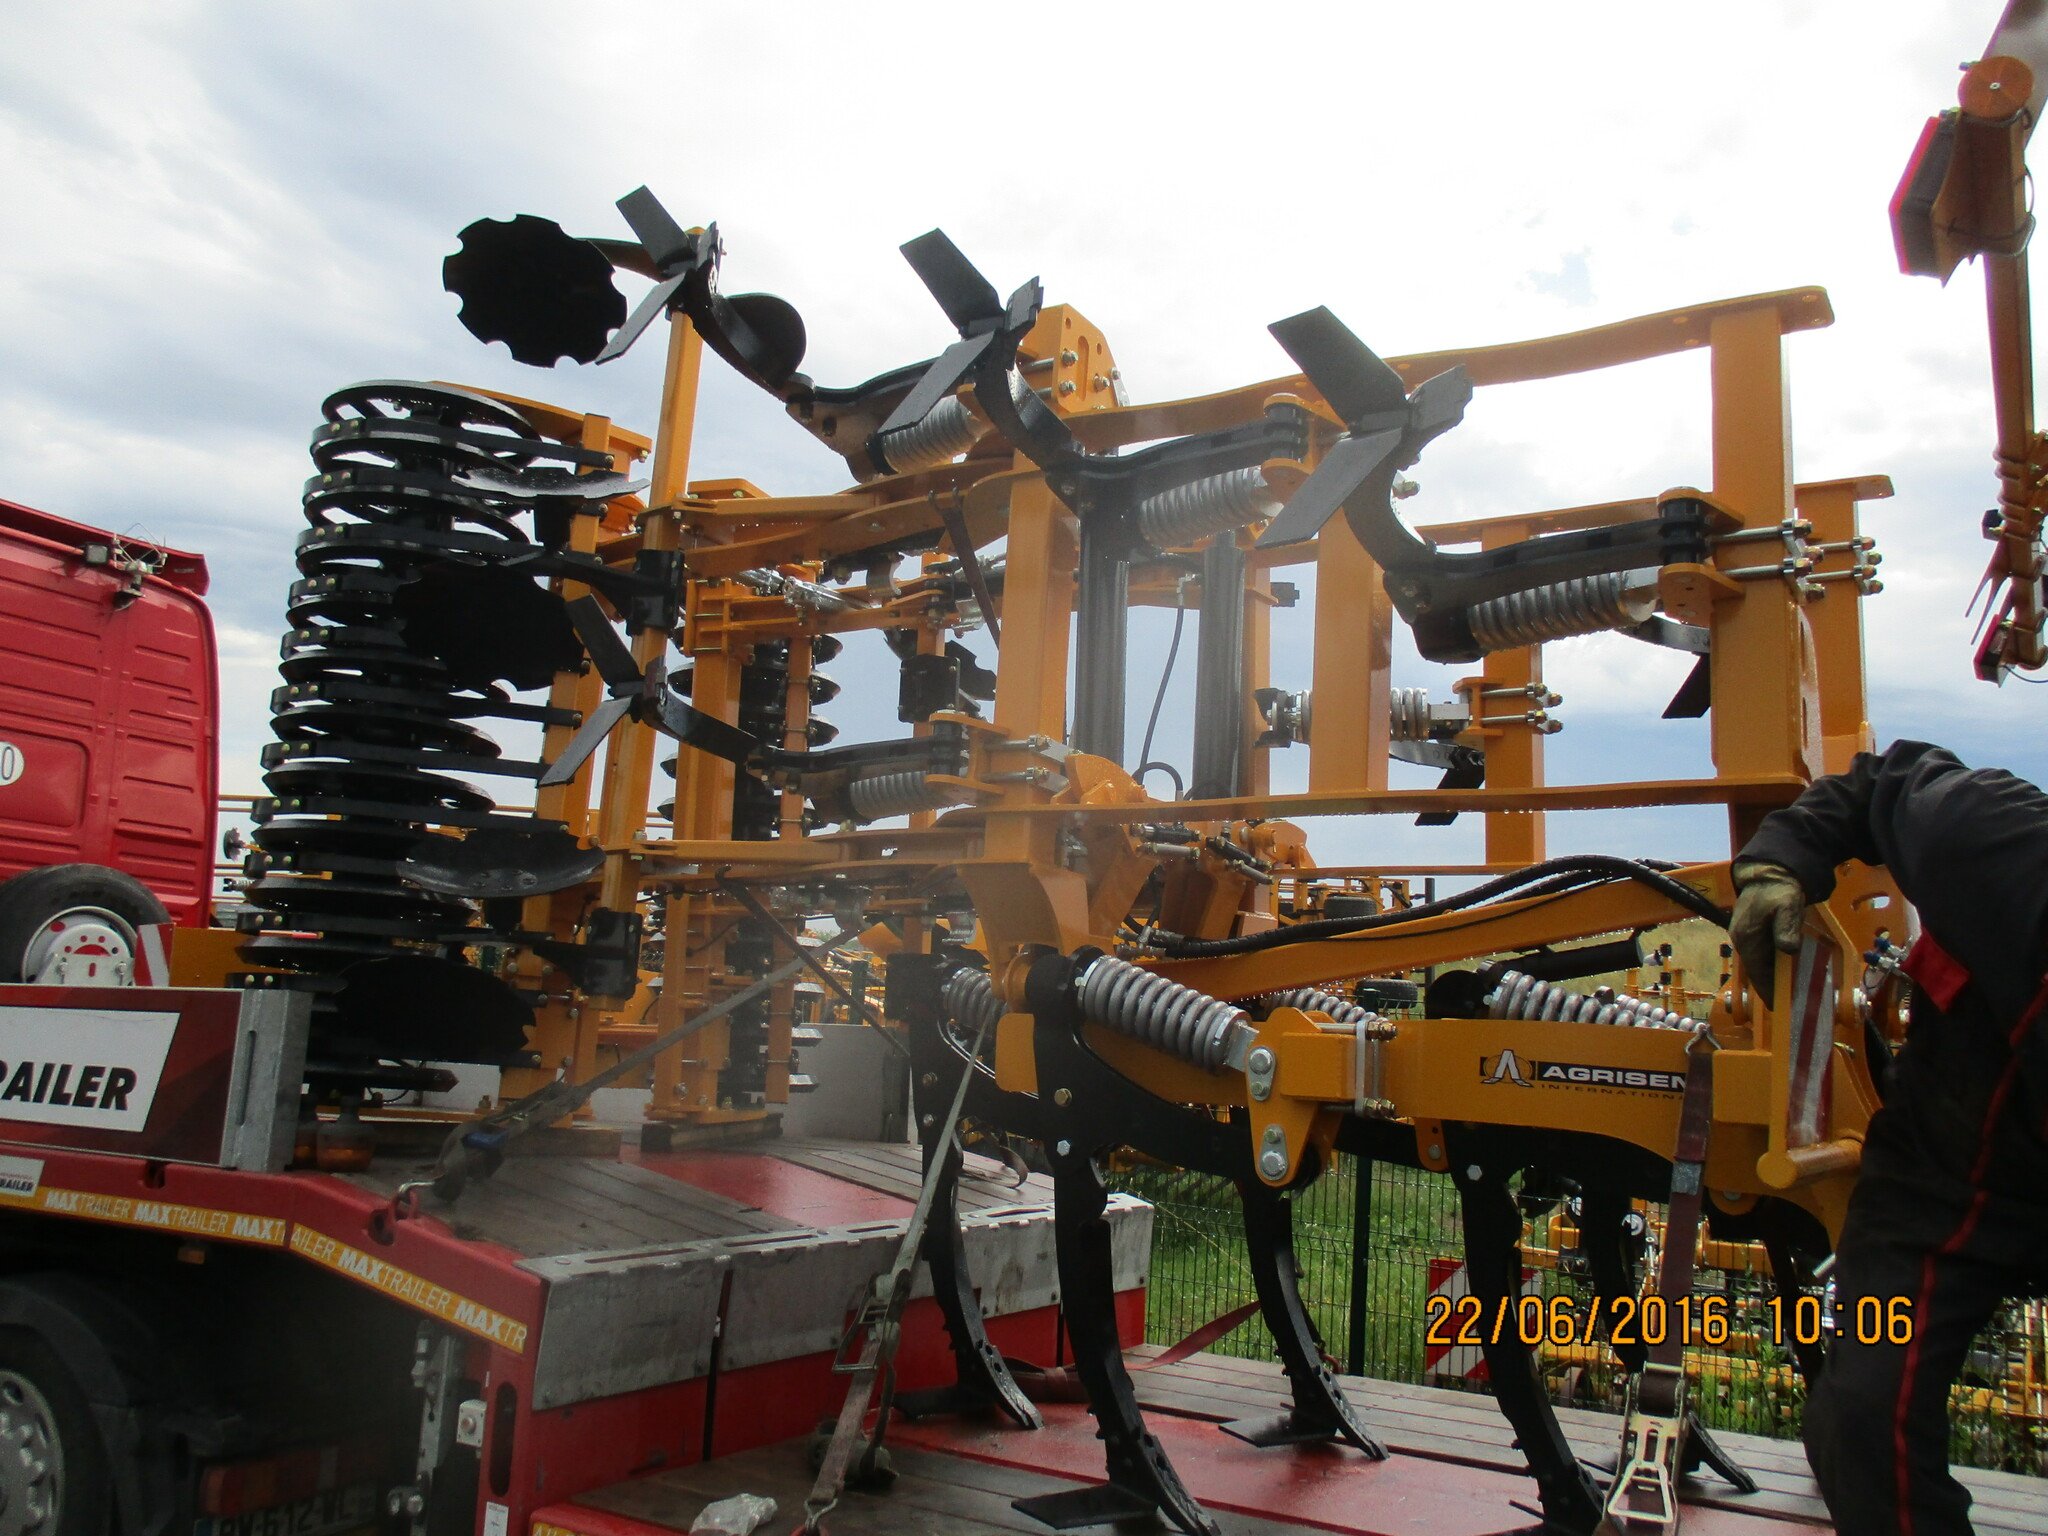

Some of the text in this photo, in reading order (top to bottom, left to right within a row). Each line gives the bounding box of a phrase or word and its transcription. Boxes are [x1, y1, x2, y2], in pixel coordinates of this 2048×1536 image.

[0, 1060, 137, 1111] AILER
[45, 1190, 286, 1243] MAXTRAILER MAXTRAILER MAXT
[337, 1247, 451, 1315] MAXTRAILER
